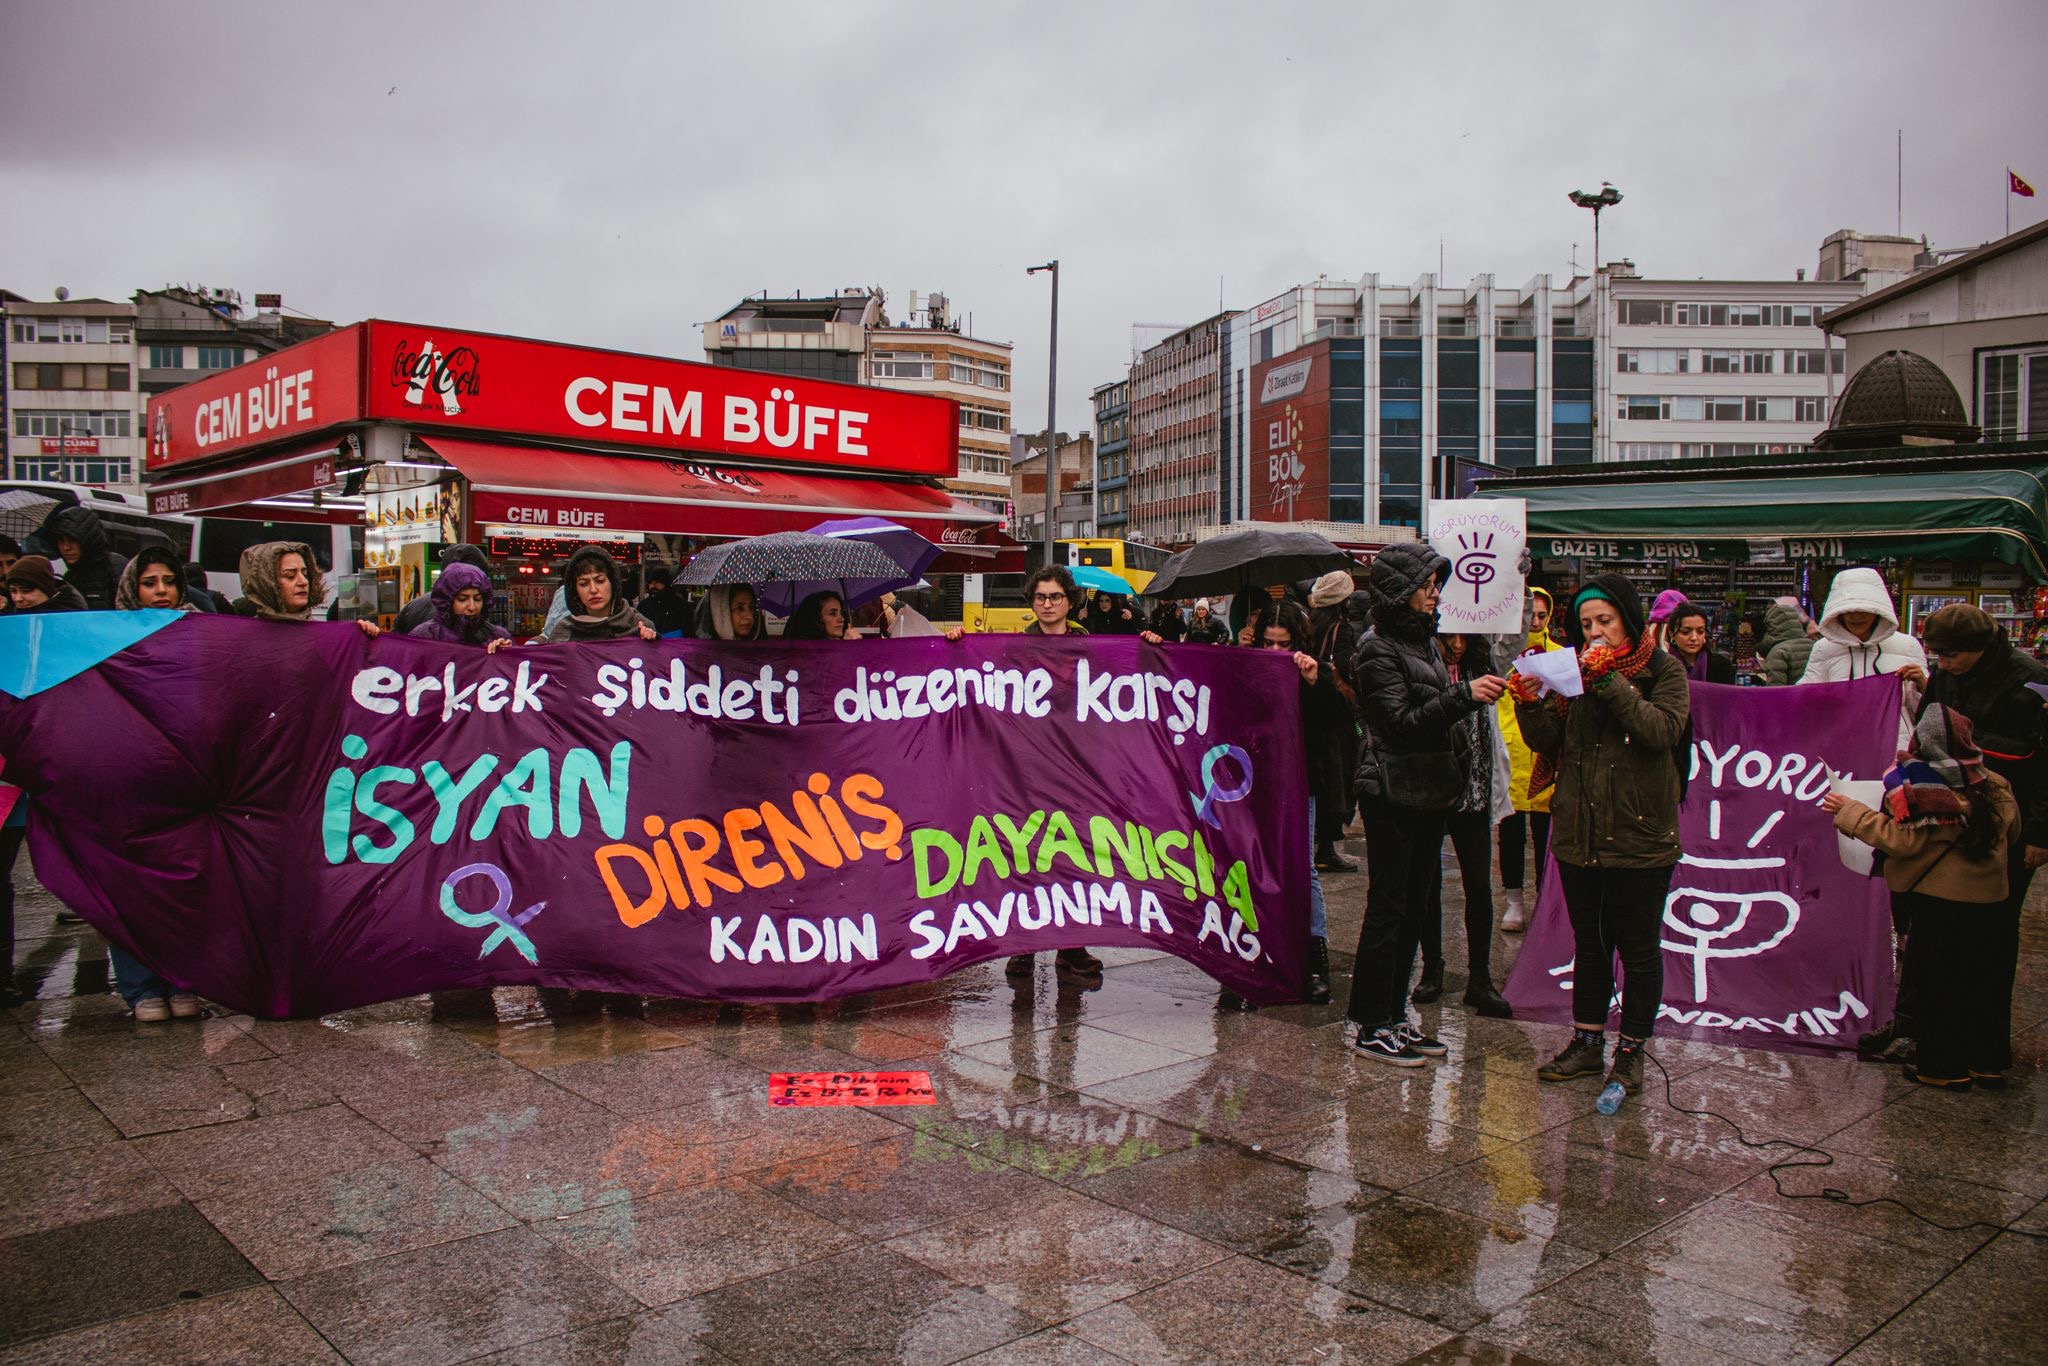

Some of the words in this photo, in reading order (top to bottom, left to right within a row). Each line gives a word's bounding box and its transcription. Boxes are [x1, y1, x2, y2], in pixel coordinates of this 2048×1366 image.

[195, 392, 242, 448] CEM
[248, 366, 314, 435] BÜFE
[1274, 374, 1289, 390] Ziraat
[564, 376, 703, 439] CEM
[723, 387, 870, 456] BÜFE
[155, 496, 169, 513] CEM
[170, 491, 189, 510] BÜFE
[507, 506, 549, 524] CEM
[557, 508, 605, 528] BÜFE
[1433, 514, 1521, 540] GÖRÜYORUM
[941, 527, 978, 544] Coca-Cola
[1550, 540, 1619, 557] GAZETE
[1643, 539, 1699, 558] DERGİ
[351, 660, 549, 722] erkek
[833, 660, 1054, 724] düzenine
[1076, 658, 1211, 746] karşı
[321, 734, 632, 865] İSYAN
[594, 772, 904, 929] DİRENİŞ
[709, 913, 879, 964] KADIN
[909, 881, 1174, 961] SAVUNMA
